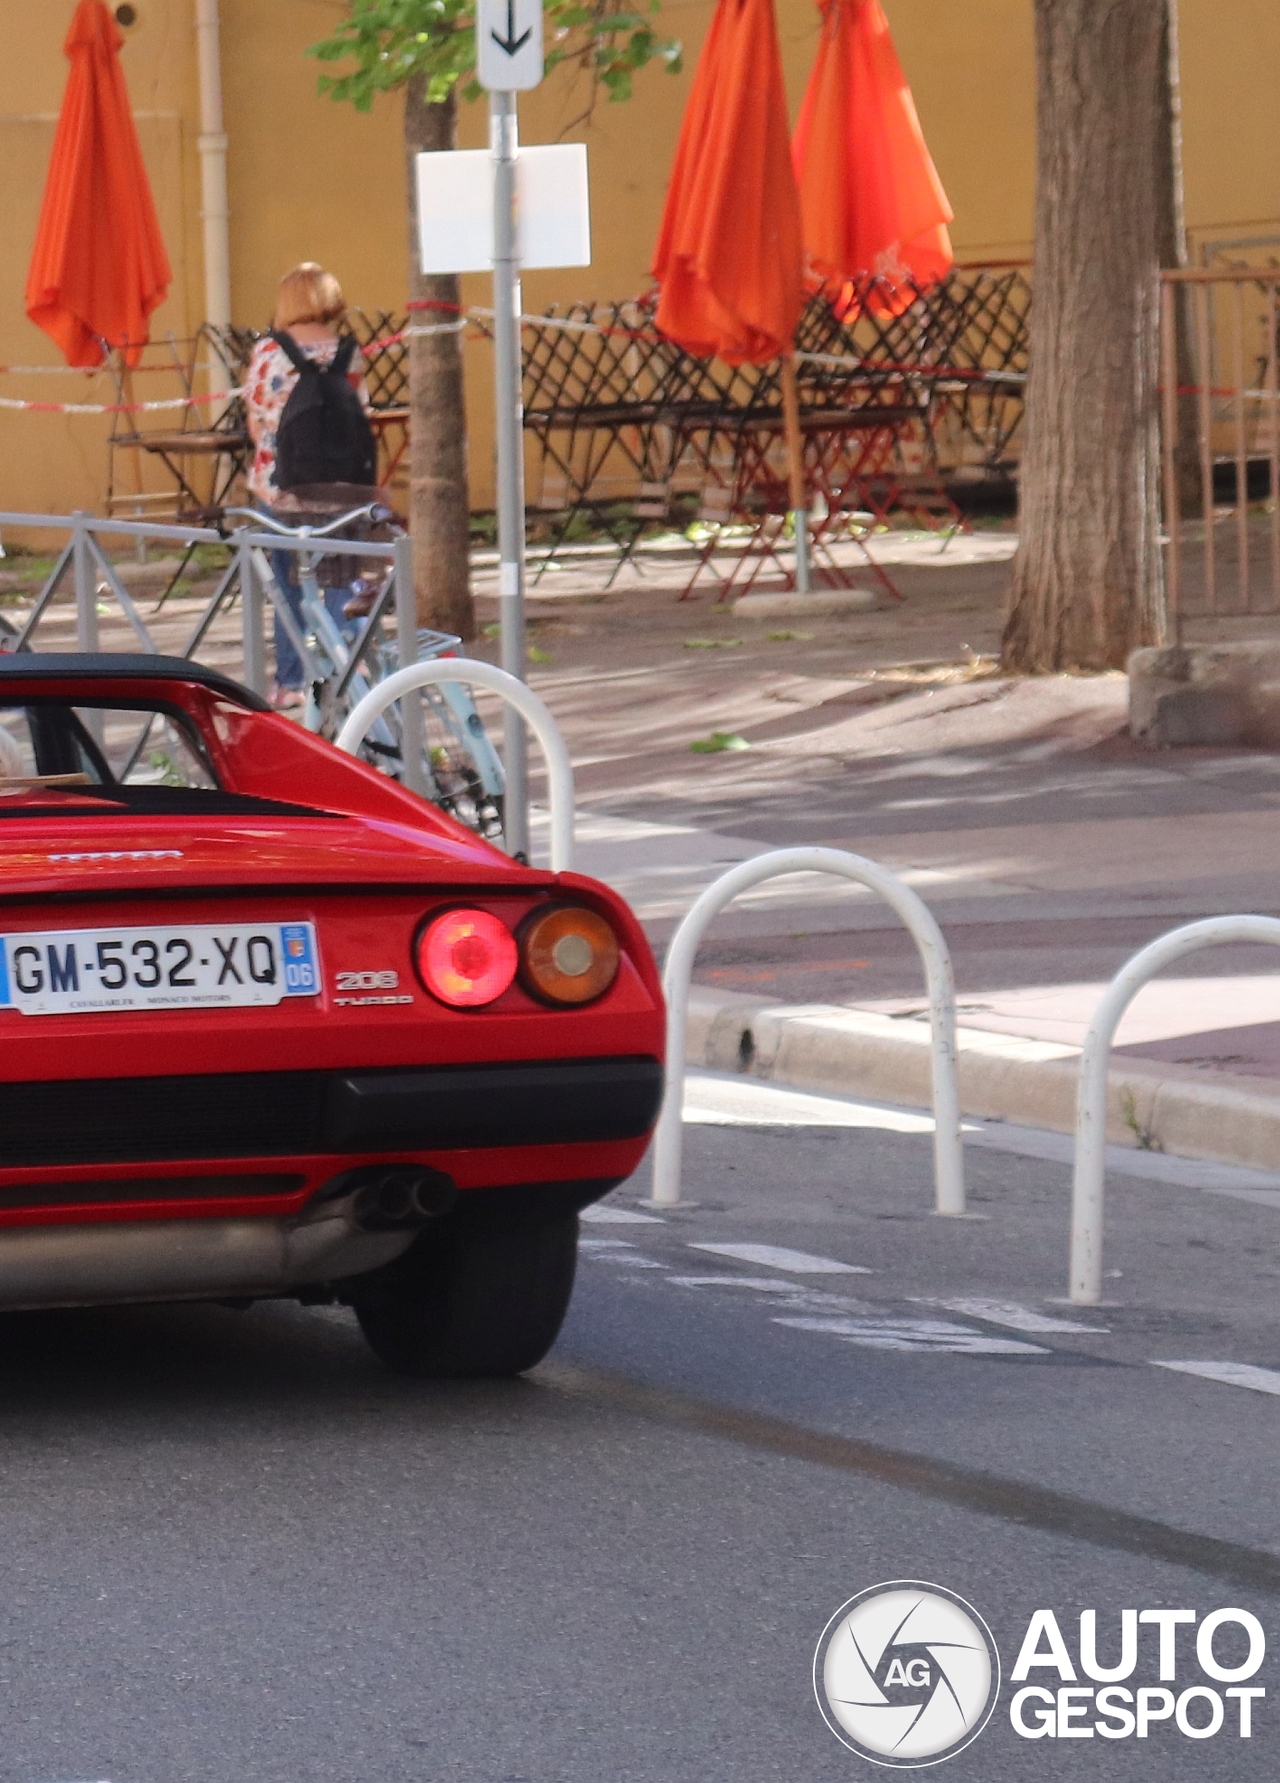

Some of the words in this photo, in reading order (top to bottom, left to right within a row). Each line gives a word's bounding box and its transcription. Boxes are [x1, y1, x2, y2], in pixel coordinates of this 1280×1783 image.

[13, 936, 277, 994] GM-532-XQ
[286, 963, 315, 987] 06
[336, 970, 399, 991] 208
